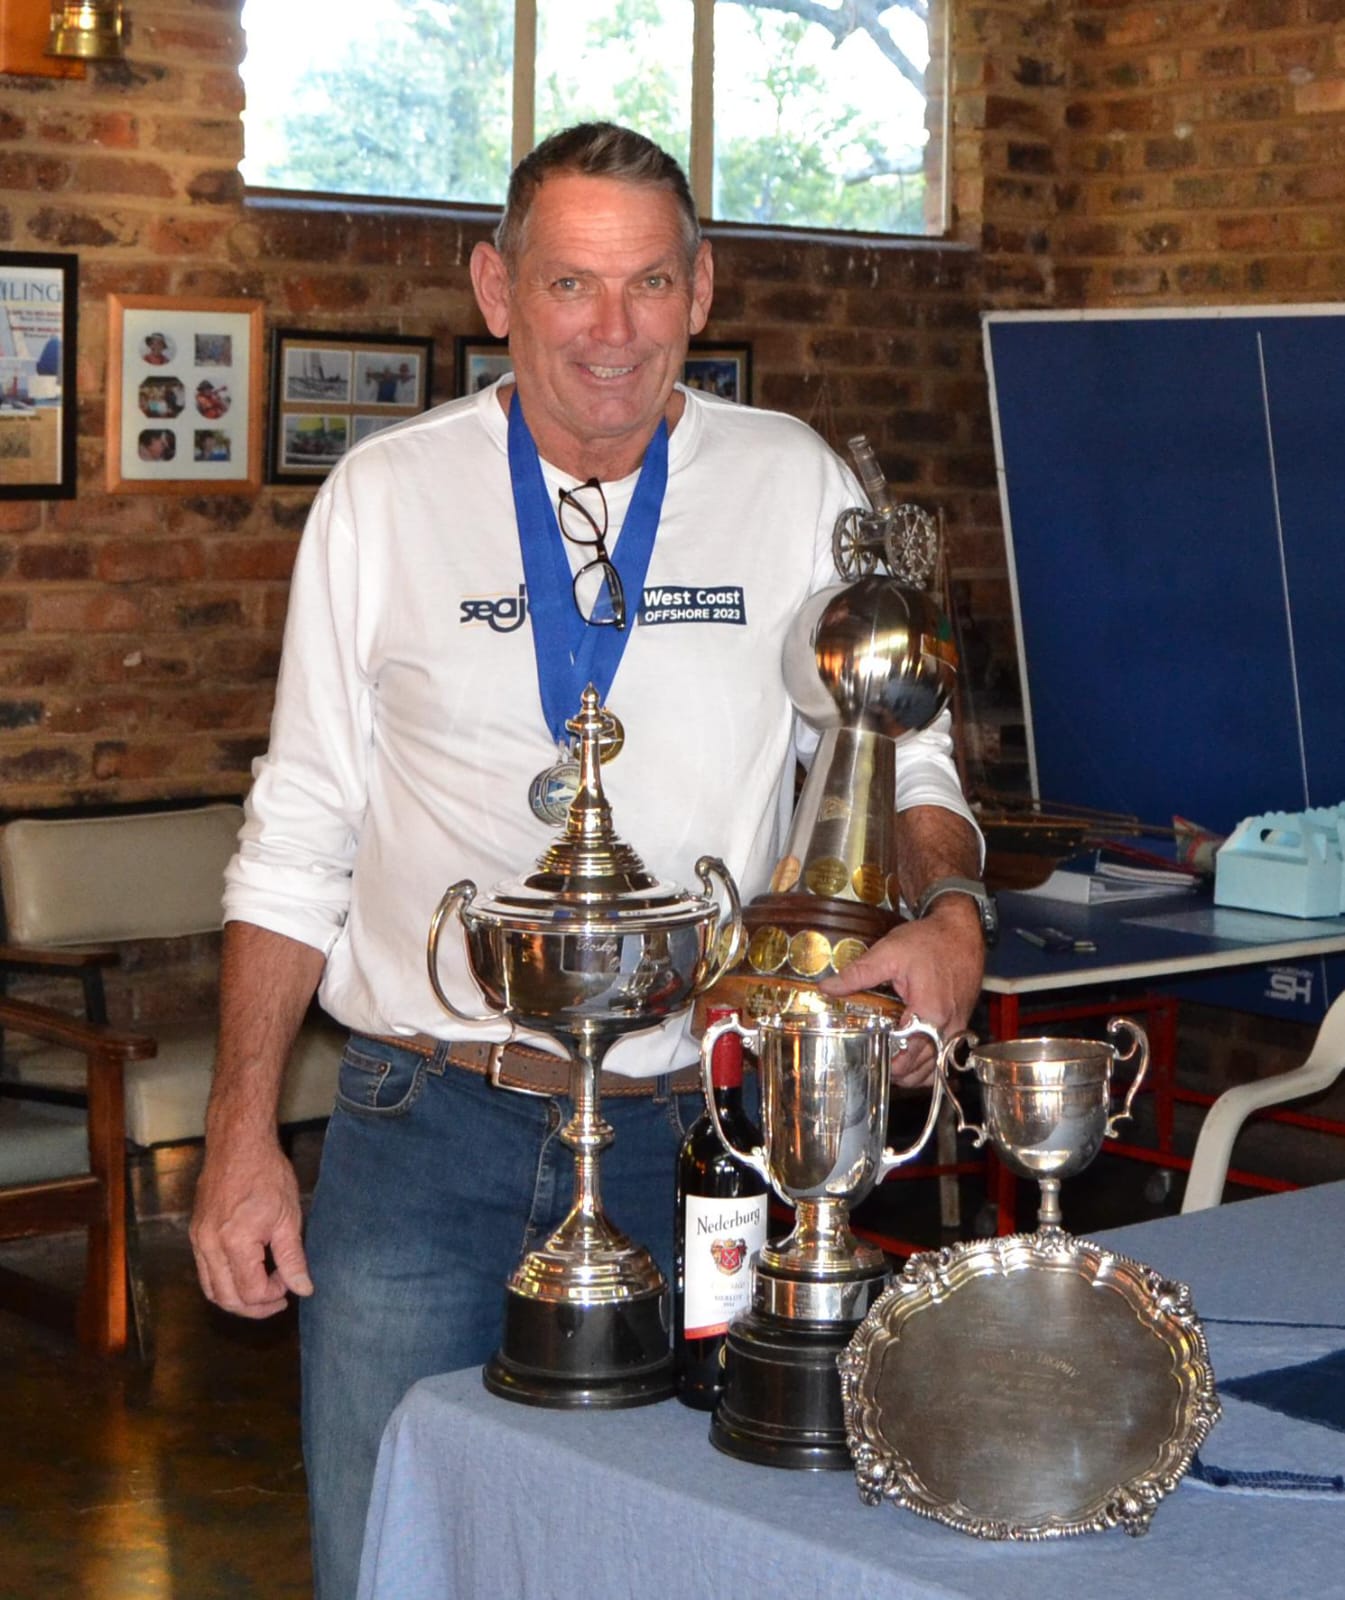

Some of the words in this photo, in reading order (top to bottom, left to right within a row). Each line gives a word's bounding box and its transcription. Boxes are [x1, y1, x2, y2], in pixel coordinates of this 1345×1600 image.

[0, 281, 62, 302] ILING
[459, 584, 527, 633] seaj
[643, 589, 691, 607] West
[696, 590, 741, 605] Coast
[644, 608, 710, 622] OFFSHORE
[712, 608, 741, 620] 2023
[696, 1206, 761, 1236] Nederburg
